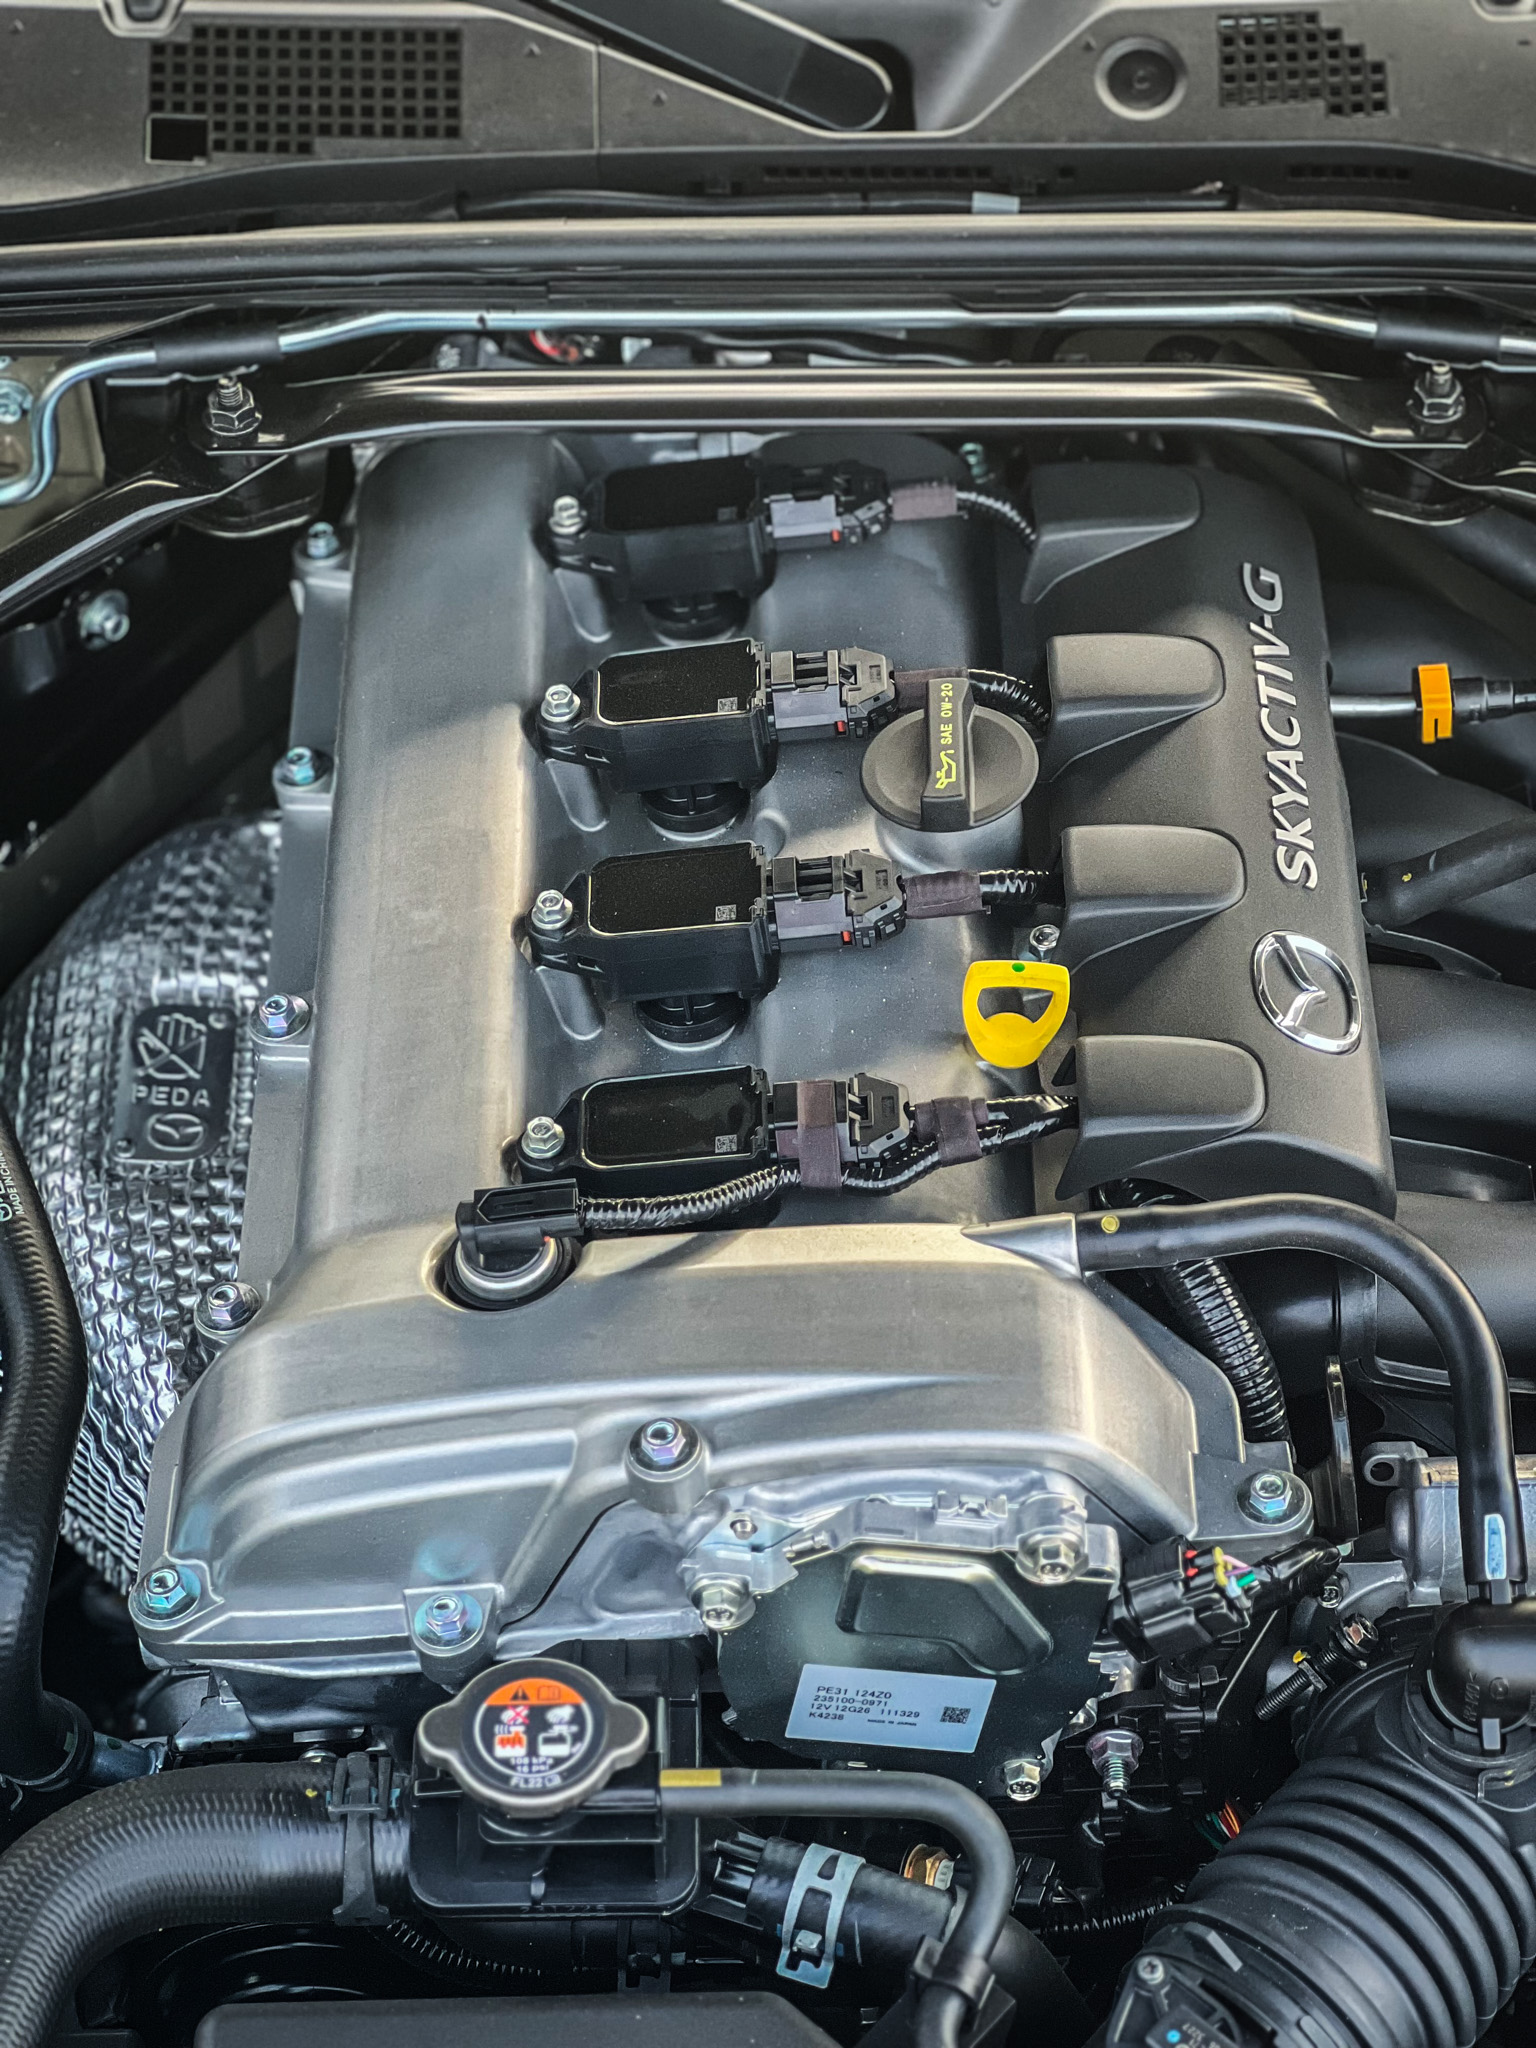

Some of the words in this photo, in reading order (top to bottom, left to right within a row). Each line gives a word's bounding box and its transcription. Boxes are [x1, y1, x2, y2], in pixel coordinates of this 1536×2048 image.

[940, 683, 953, 718] 0W-20
[1243, 562, 1318, 890] SKYACTIV-G
[940, 723, 953, 745] SAE
[132, 1083, 211, 1108] PEDA
[3, 1176, 15, 1186] IN
[7, 1187, 25, 1215] MADE
[816, 1686, 848, 1696] PE31
[856, 1690, 892, 1699] 124Z0
[813, 1695, 888, 1707] 235100-0971
[808, 1711, 845, 1721] K4238
[880, 1709, 920, 1718] 111329
[510, 1776, 543, 1789] FL22
